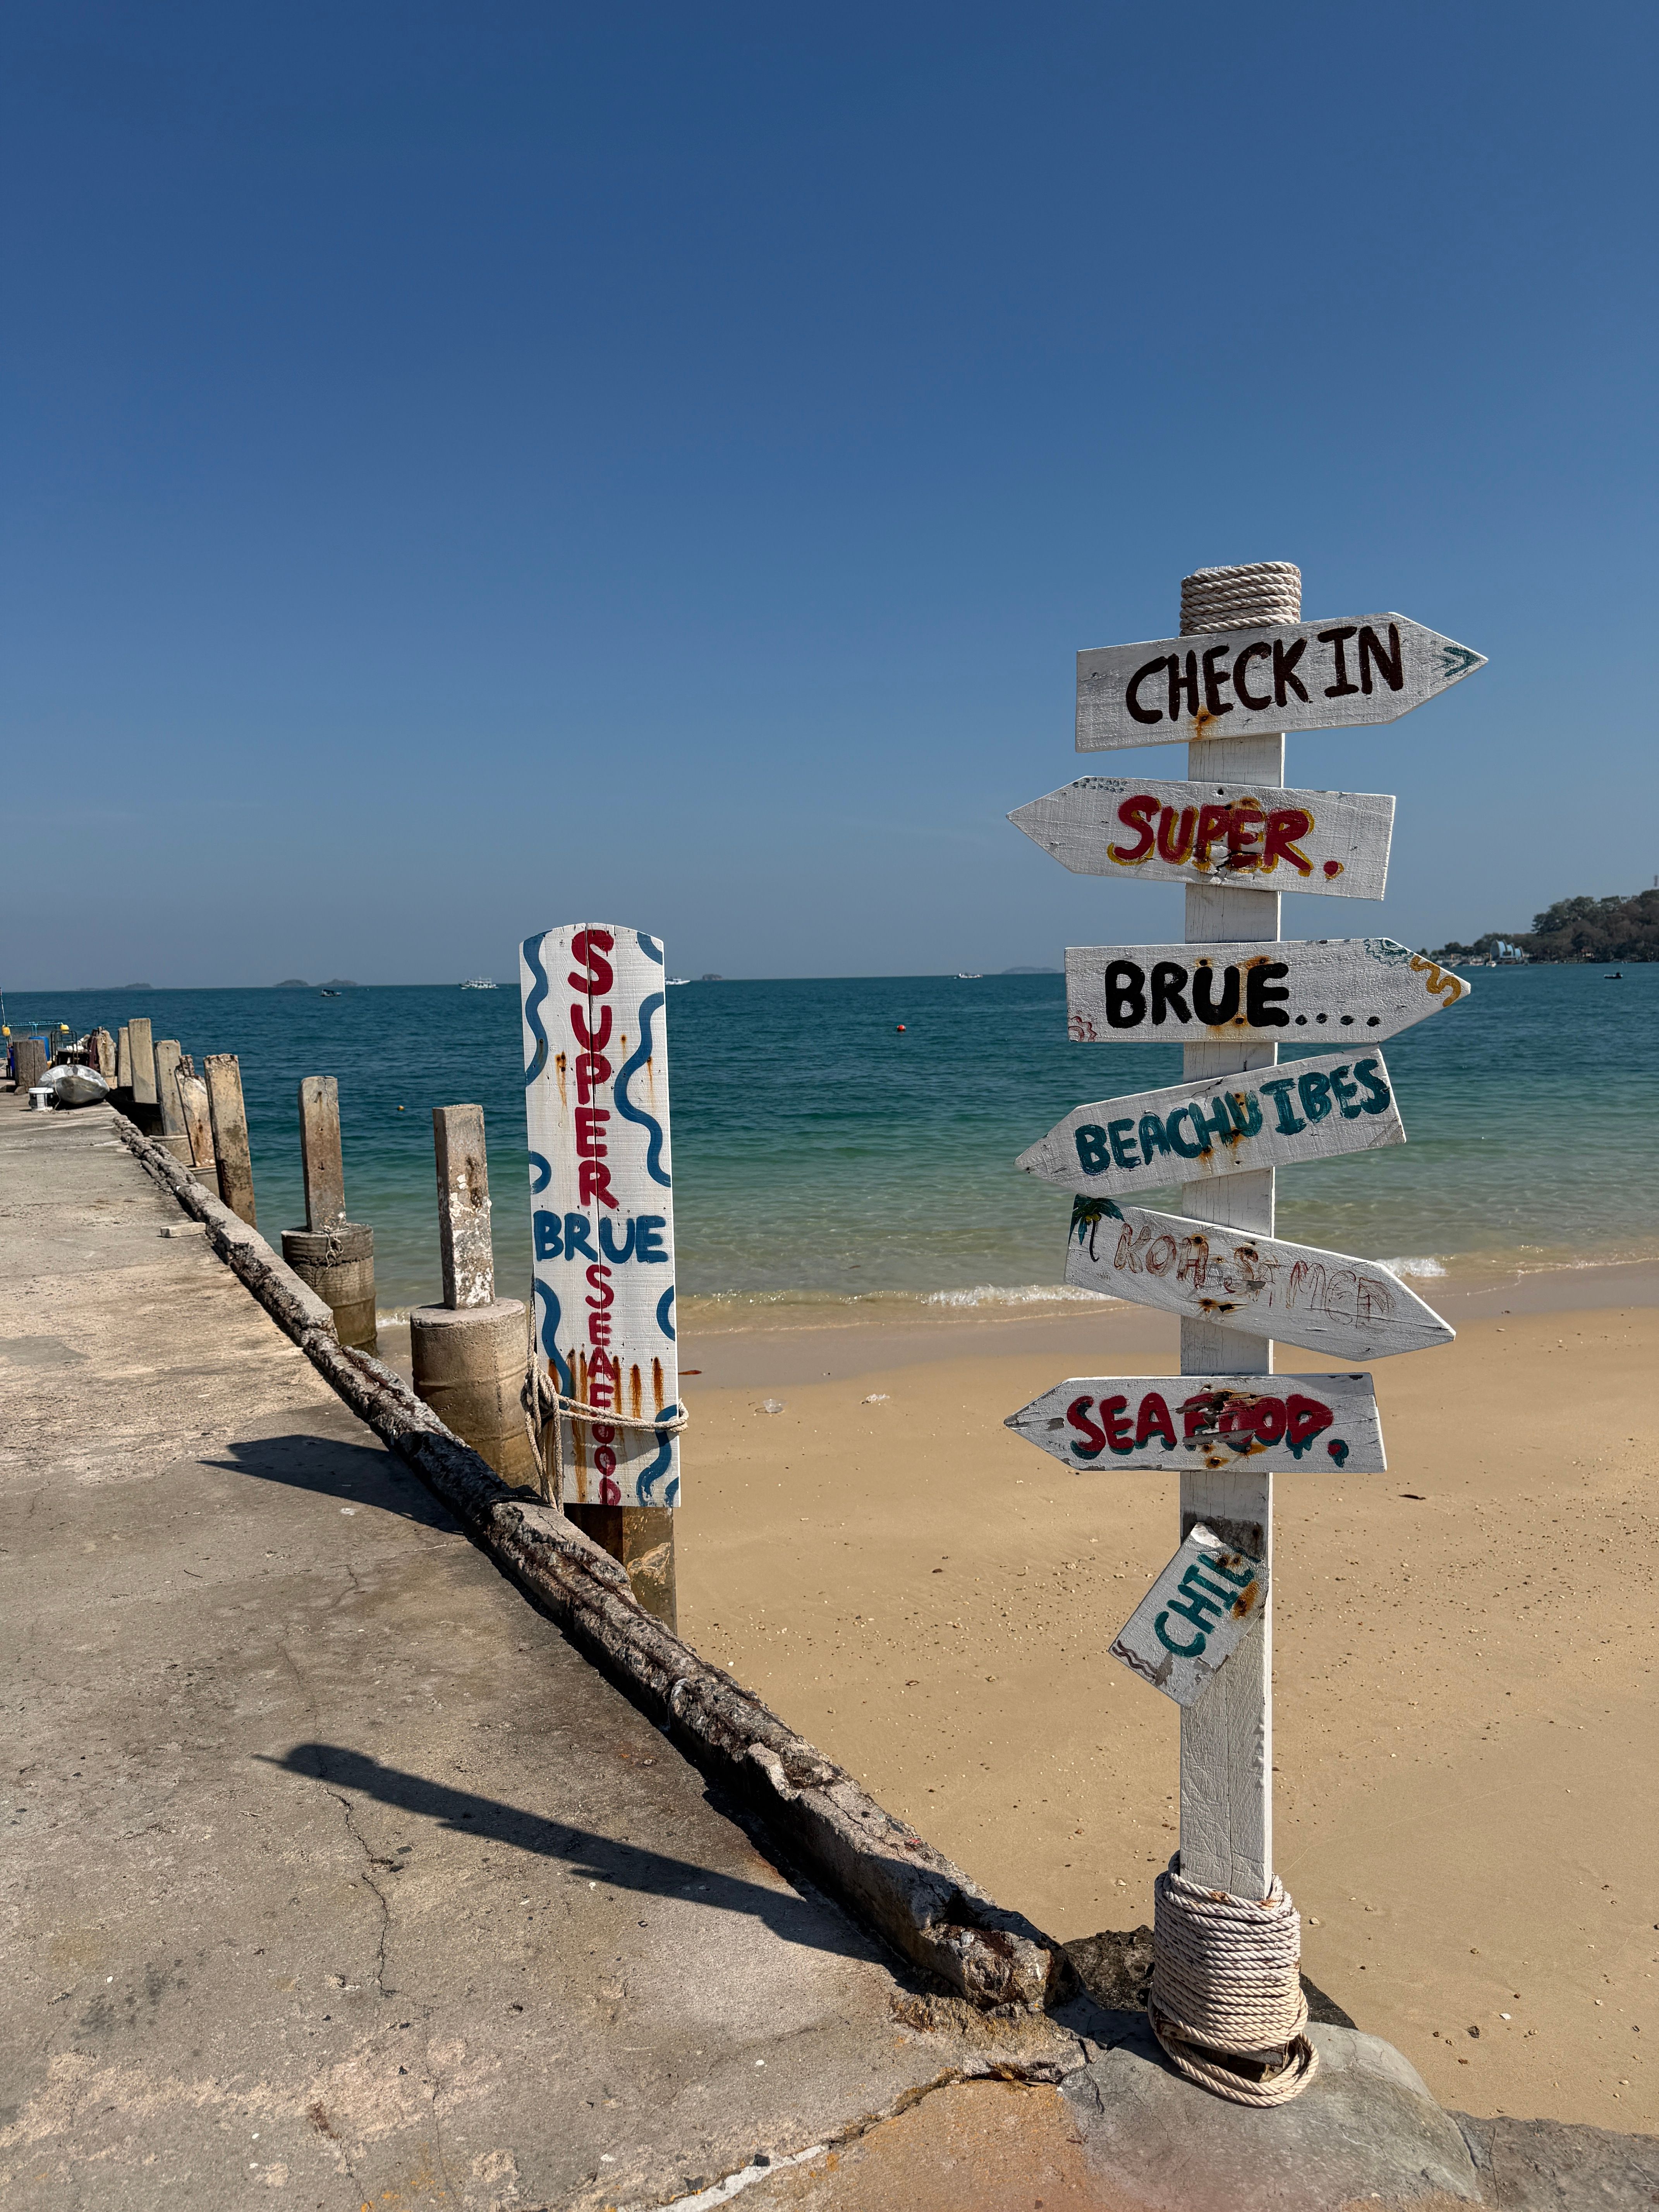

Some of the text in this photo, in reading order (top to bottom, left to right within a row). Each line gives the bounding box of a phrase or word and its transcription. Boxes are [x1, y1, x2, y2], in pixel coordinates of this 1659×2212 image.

[1126, 622, 1403, 724] CHECK IN
[568, 929, 620, 1209] SUPER
[1075, 1096, 1234, 1176] BEACH
[533, 1210, 669, 1264] BRUE
[1114, 1223, 1209, 1290] KOH
